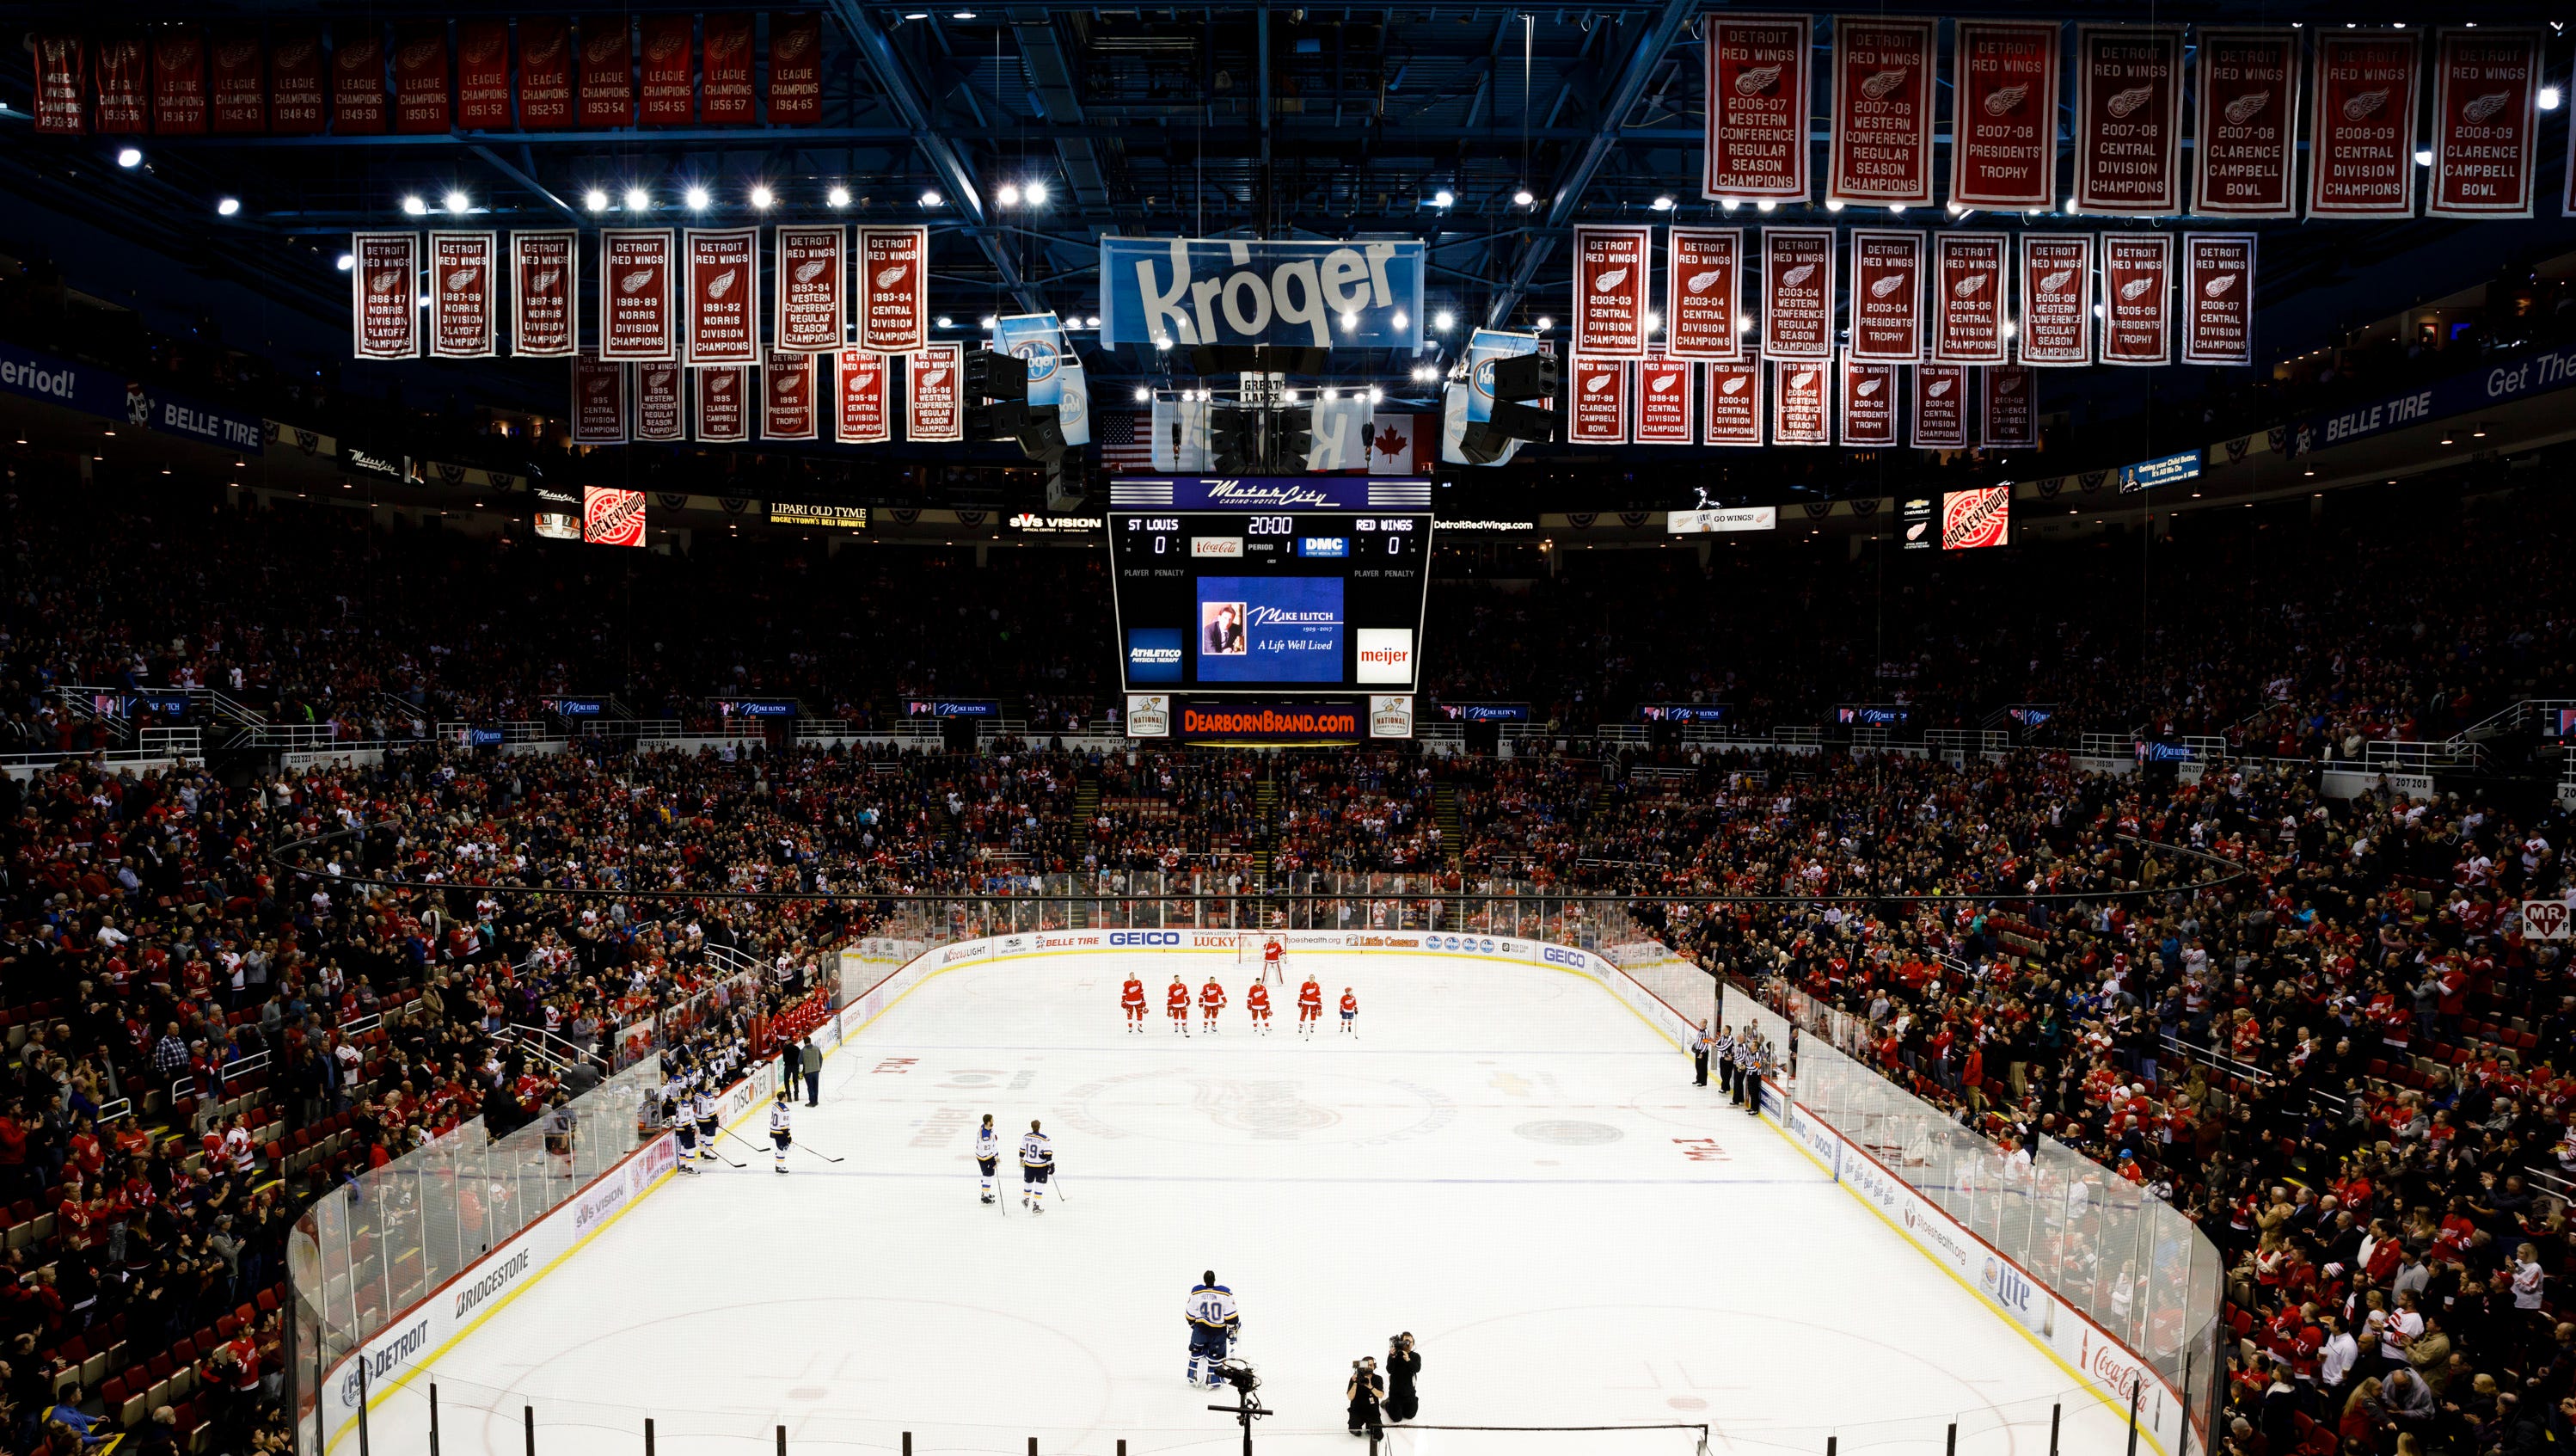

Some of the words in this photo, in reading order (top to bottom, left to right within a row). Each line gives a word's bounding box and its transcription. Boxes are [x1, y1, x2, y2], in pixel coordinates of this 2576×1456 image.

[1729, 31, 1788, 43] DETROIT
[1721, 48, 1748, 60] RED
[1755, 49, 1794, 62] WINGS
[777, 69, 813, 81] LEAGUE
[771, 83, 819, 95] CHAMPIONS
[776, 99, 813, 111] 1964-65
[1728, 98, 1787, 111] 2006-07
[1728, 114, 1787, 126] WESTERN
[1720, 127, 1794, 143] CONFERENCE
[1728, 144, 1786, 157] REGULAR
[1732, 159, 1782, 172] SEASON
[1719, 174, 1794, 188] CHAMPIONS
[616, 243, 659, 252] DETROIT
[1590, 241, 1634, 251] DETROIT
[1585, 254, 1605, 263] RED
[1608, 254, 1638, 263] WINGS
[2117, 248, 2157, 258] DETROIT
[611, 255, 631, 265] RED
[635, 255, 664, 265] WINGS
[2113, 260, 2131, 269] RED
[2134, 260, 2162, 270] WINGS
[616, 298, 658, 306] 1988-89
[1590, 295, 1632, 304] 2002-03
[619, 310, 655, 320] NORRIS
[1590, 309, 1632, 319] CENTRAL
[2116, 305, 2157, 316] 2005-06
[616, 323, 659, 333] DIVISION
[1589, 321, 1632, 332] DIVISION
[2111, 320, 2162, 330] PRESIDENTS'
[610, 336, 664, 346] CHAMPIONS
[1583, 335, 1637, 346] CHAMPIONS
[2118, 334, 2153, 345] TROPHY
[859, 362, 881, 371] WINGS
[2487, 362, 2529, 397] Get
[2326, 405, 2382, 442] BELLE
[2388, 390, 2432, 425] TIRE
[164, 403, 218, 437] BELLE
[224, 419, 259, 447] TIRE
[771, 502, 808, 515] LIPARI
[810, 506, 833, 516] OLD
[834, 507, 867, 519] TYME
[586, 492, 646, 542] HOCKEYTOWN
[770, 516, 820, 525] HOCKEYTOWN'S
[837, 519, 866, 528] FAVORITE
[1046, 518, 1101, 528] VISION
[1944, 488, 2008, 548] HOCKEYTOWN
[1128, 519, 1142, 531] ST
[1146, 519, 1179, 531] LOUIS
[1248, 517, 1292, 535] 20:00
[1356, 519, 1376, 531] RED
[1380, 519, 1413, 531] WINGS
[1433, 519, 1533, 531] DetroitRedWings.com
[1154, 536, 1166, 554] 0
[1285, 540, 1291, 553] 1
[1305, 538, 1343, 550] DMC
[1388, 536, 1400, 555] 0
[1247, 605, 1297, 627] MIKE
[1299, 611, 1334, 621] ILITCH
[1258, 641, 1267, 650] A
[1268, 640, 1285, 653] Life
[1287, 640, 1307, 650] Well
[1308, 640, 1333, 650] Lived
[1130, 648, 1181, 658] ATHLETICO
[1361, 647, 1408, 666] meijer
[741, 702, 767, 716] MIKE
[938, 702, 968, 716] MIKE
[1133, 716, 1162, 724] NATIONAL
[1377, 716, 1406, 725] NATIONAL
[290, 755, 301, 764] 222
[2395, 777, 2410, 788] 207
[2412, 778, 2427, 788] 208
[2529, 906, 2565, 921] MR.
[1046, 937, 1074, 947] BELLE
[1077, 937, 1100, 945] TIRE
[1109, 931, 1180, 946] GEICO
[1193, 937, 1236, 947] LUCKY
[1359, 936, 1383, 947] Little
[1384, 937, 1420, 948] Caesars
[966, 945, 986, 957] LIGHT
[1544, 947, 1585, 968] GEICO
[1026, 1142, 1038, 1158] 19
[1815, 1133, 1832, 1159] DOCS
[647, 1132, 674, 1174] NATIONAL
[596, 1184, 624, 1213] VISION
[455, 1248, 529, 1320] BRIDGESTONE
[1997, 1262, 2031, 1312] Lite
[1199, 1301, 1223, 1321] 40
[375, 1318, 428, 1379] DETROIT
